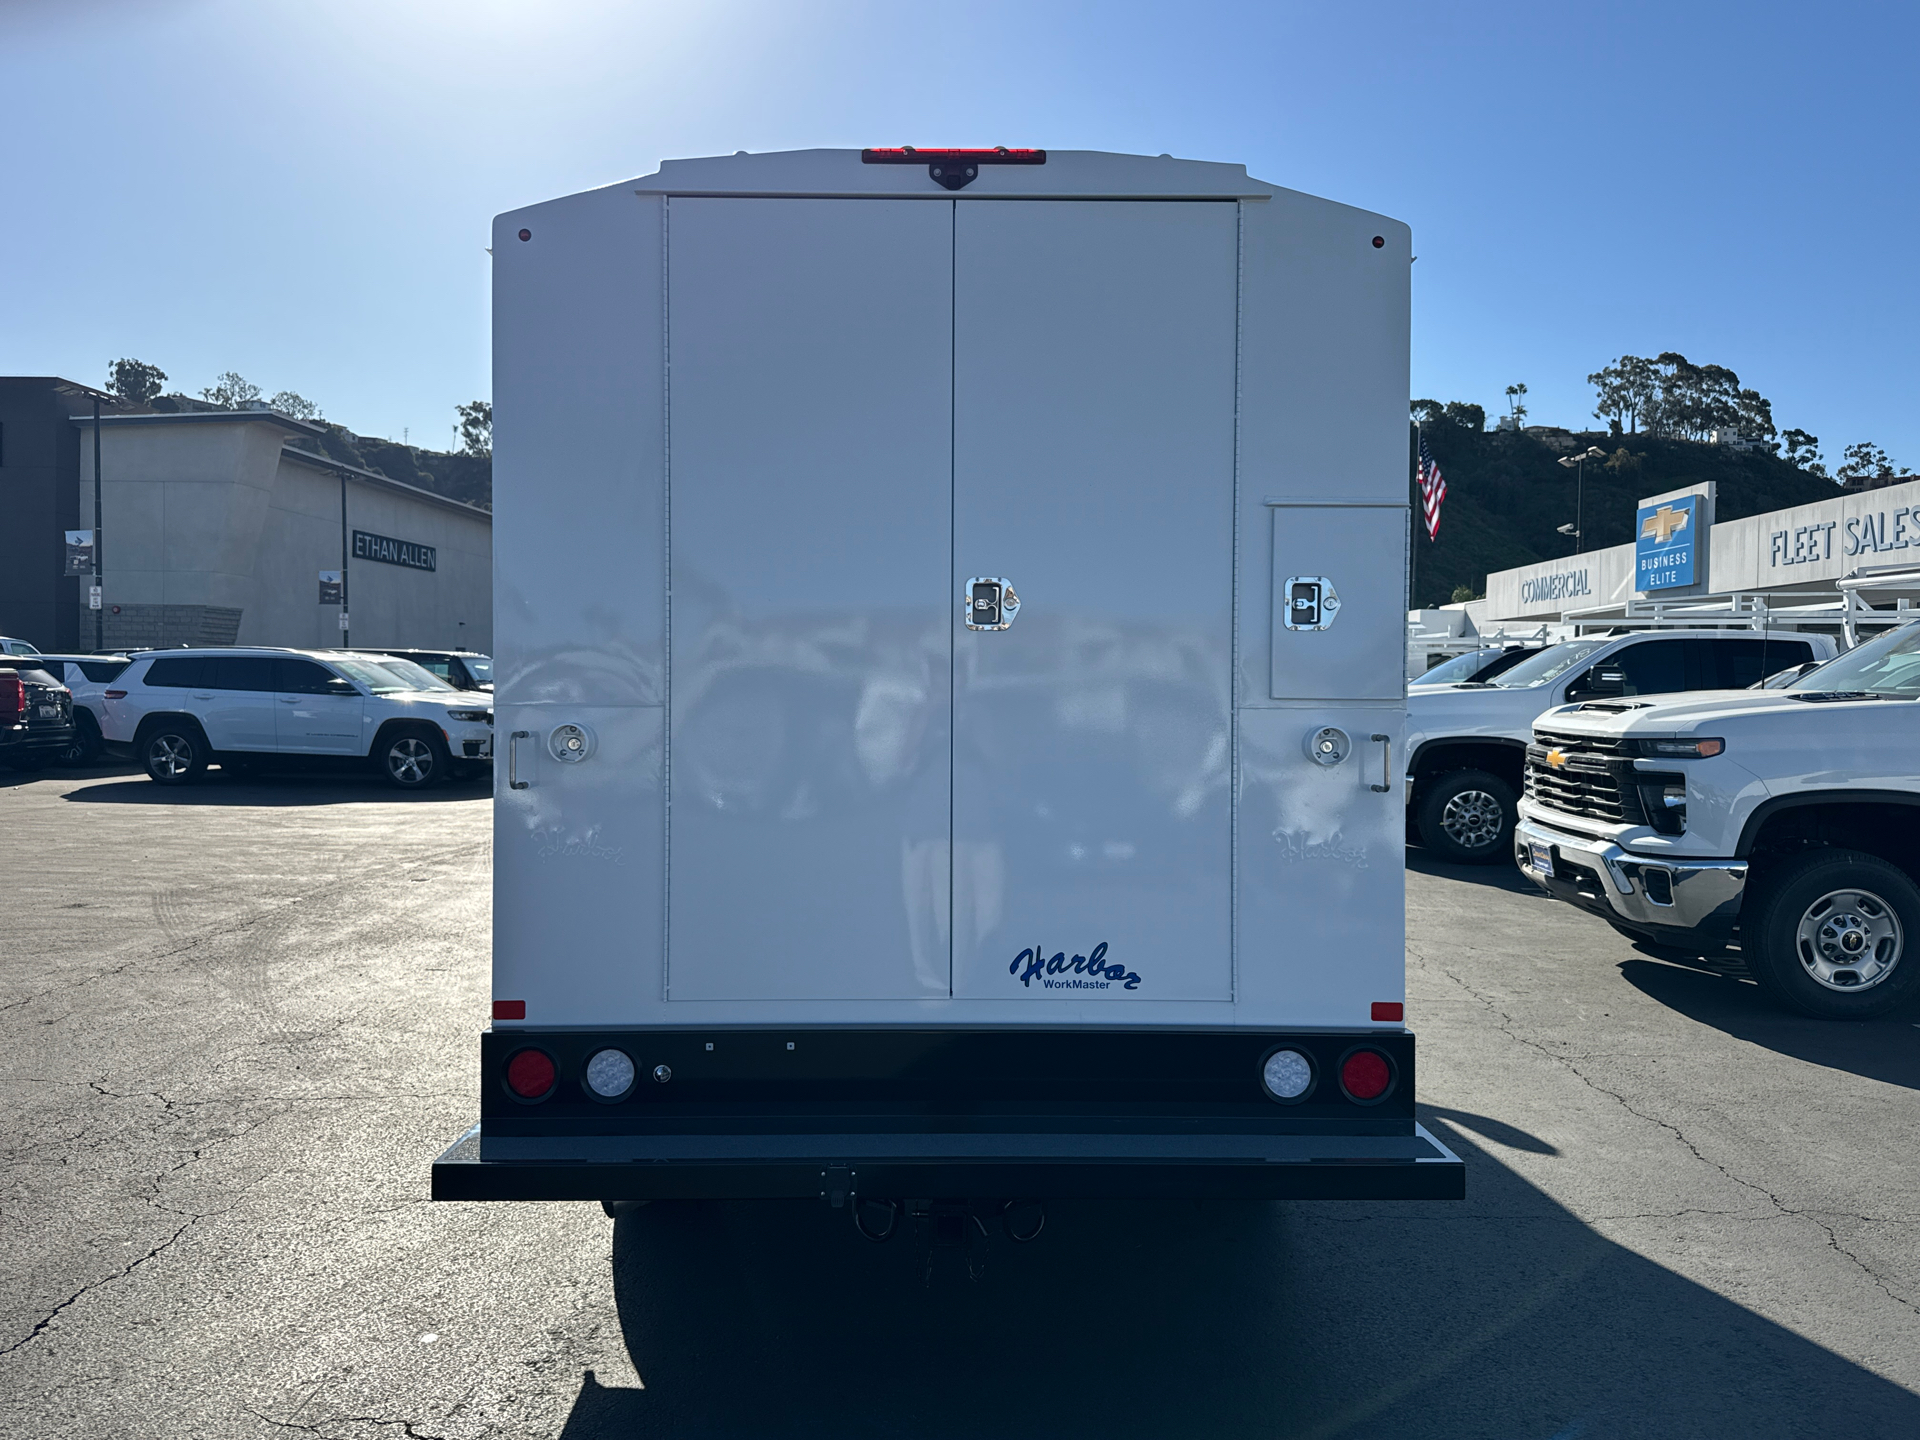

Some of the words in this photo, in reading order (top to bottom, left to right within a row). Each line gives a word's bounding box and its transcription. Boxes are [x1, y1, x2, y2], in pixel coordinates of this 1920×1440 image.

[356, 533, 398, 562] ETHAN
[400, 544, 435, 569] ALLEN
[1770, 520, 1837, 567] FLEET
[1843, 504, 1920, 556] SALES
[1641, 552, 1687, 571] BUSINESS
[1650, 571, 1677, 585] ELITE
[1521, 568, 1592, 604] COMMERCIAL
[1272, 829, 1369, 868] Harbor
[1009, 941, 1142, 990] Harbor
[1043, 979, 1111, 989] WorkMaster
